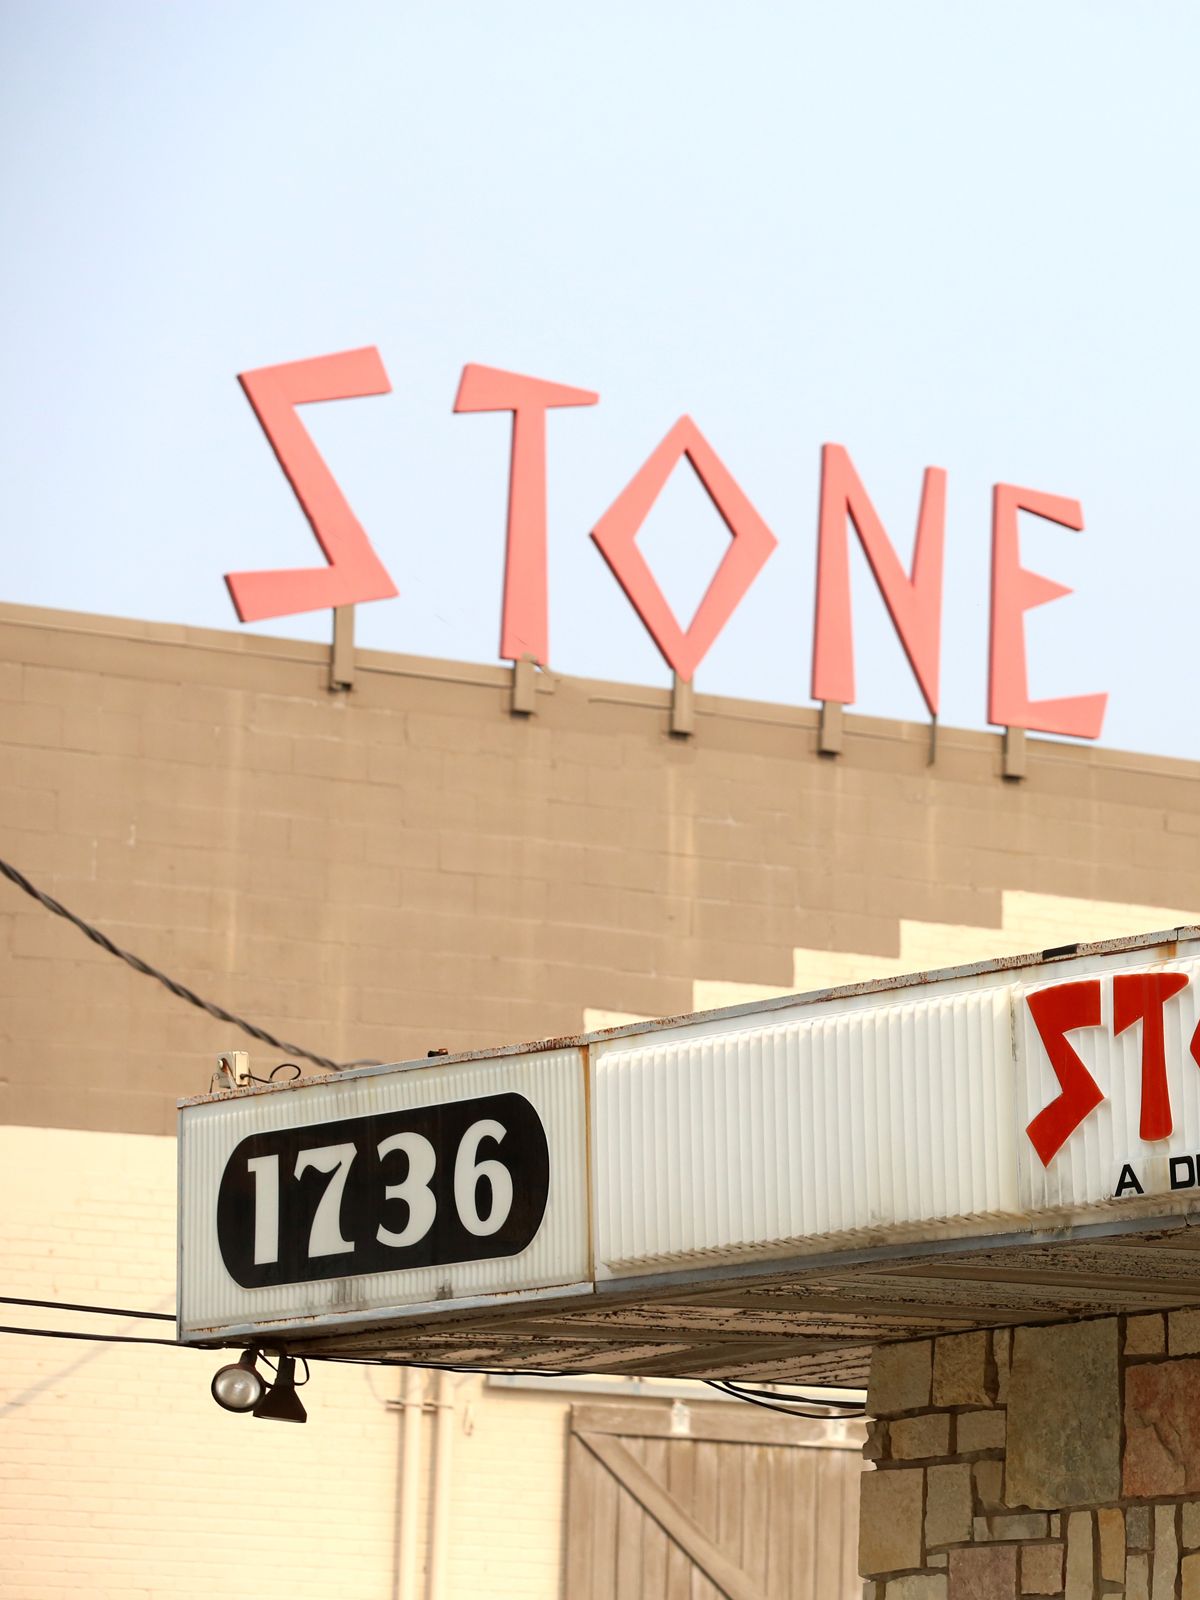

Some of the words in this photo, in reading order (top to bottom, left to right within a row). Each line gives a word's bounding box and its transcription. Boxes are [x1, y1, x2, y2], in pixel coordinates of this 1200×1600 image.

[223, 346, 1108, 738] STONE
[247, 1118, 514, 1266] 1736
[1115, 1164, 1144, 1197] A
